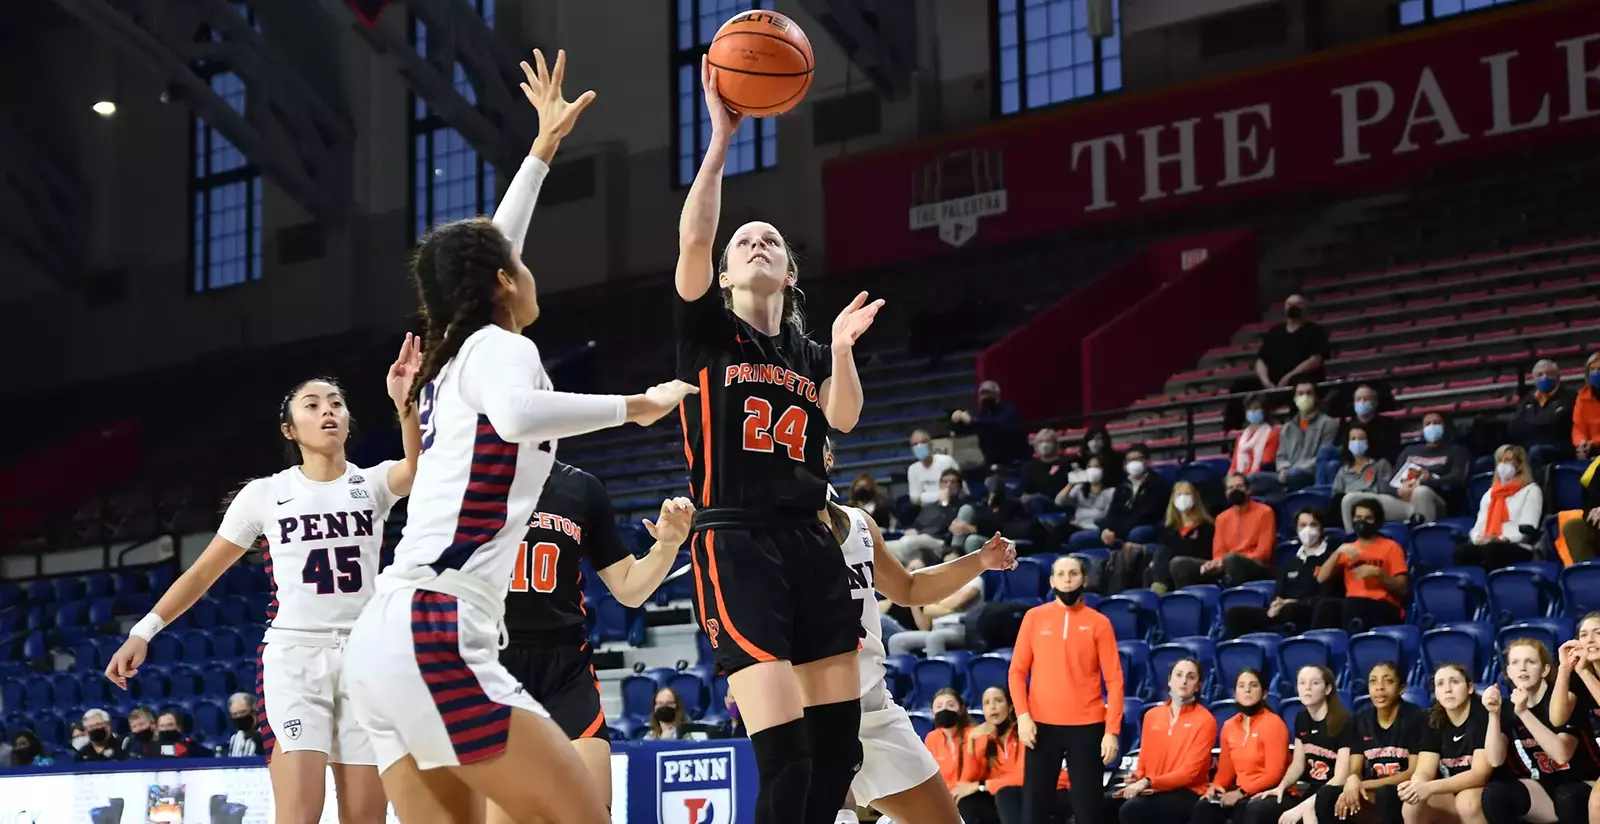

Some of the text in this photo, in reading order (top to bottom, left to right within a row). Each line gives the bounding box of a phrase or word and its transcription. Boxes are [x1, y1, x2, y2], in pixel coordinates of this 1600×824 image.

[1071, 33, 1600, 212] THE PALE
[724, 362, 821, 409] PRINCETO
[742, 395, 809, 463] 24
[278, 509, 374, 545] PENN
[301, 545, 362, 595] 45
[509, 540, 560, 594] 10
[663, 757, 729, 784] PENN
